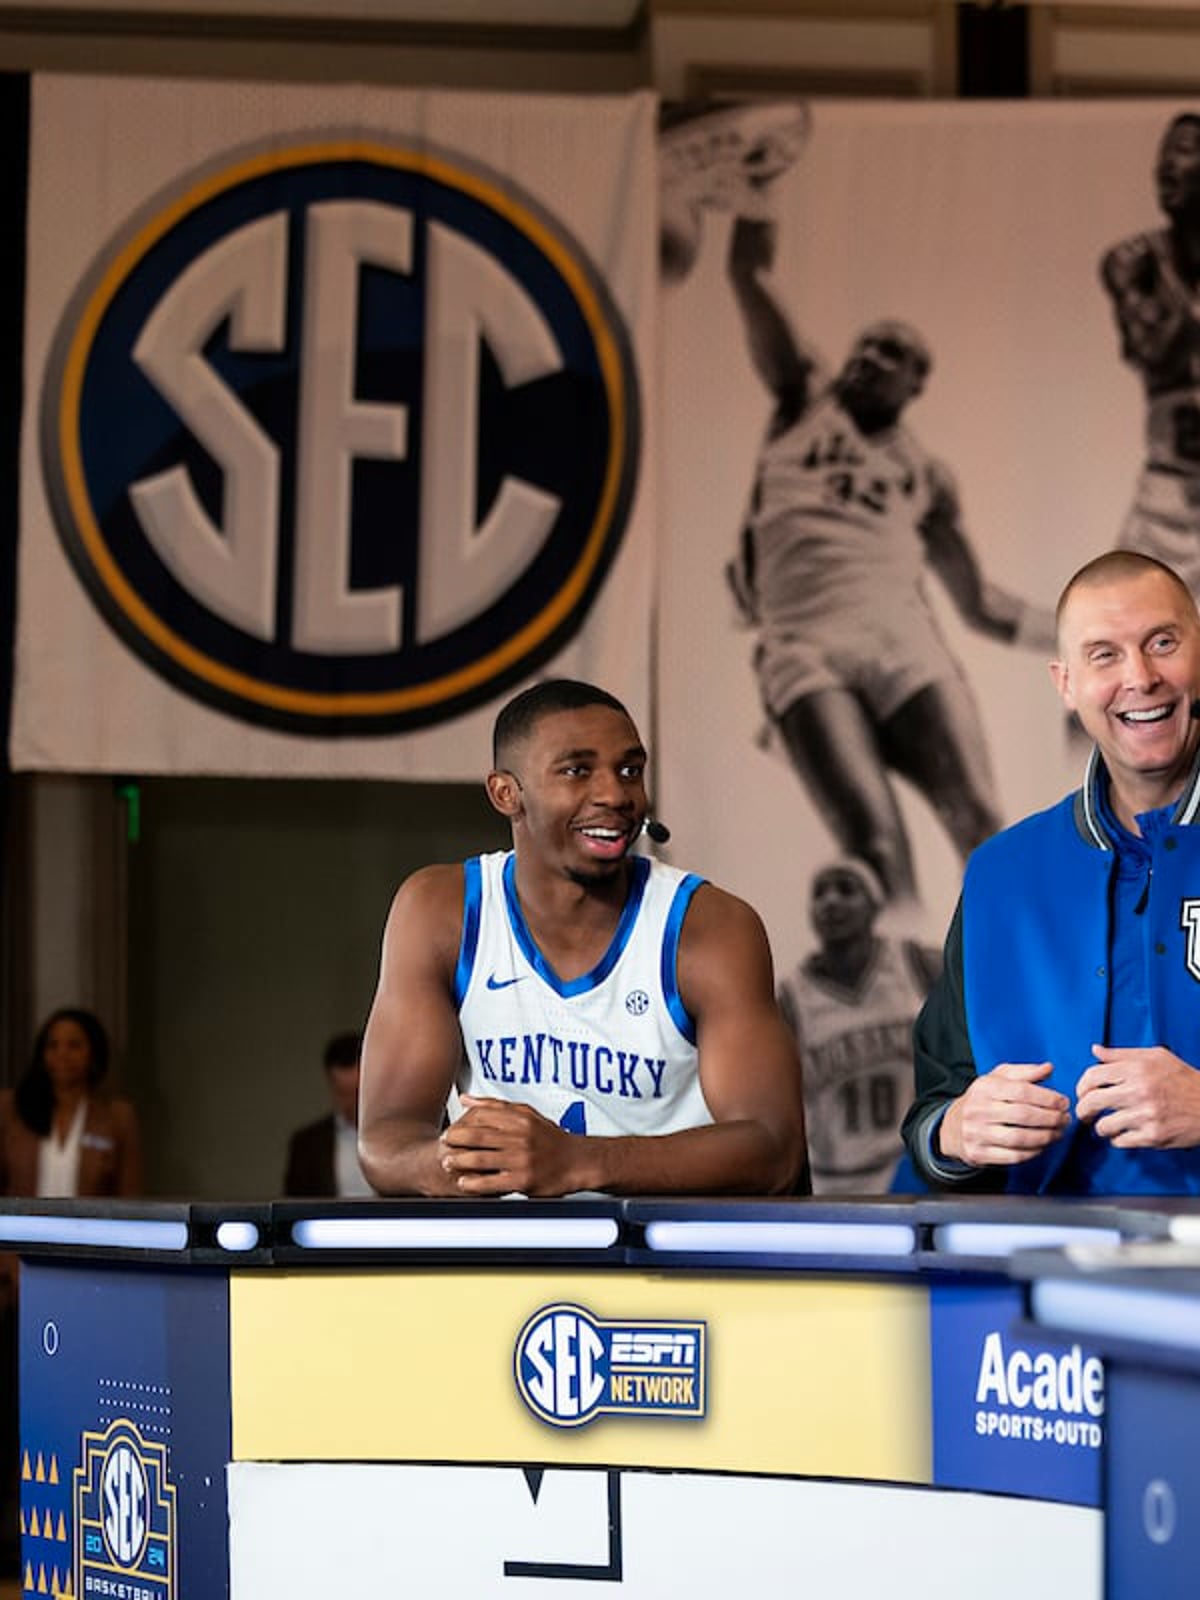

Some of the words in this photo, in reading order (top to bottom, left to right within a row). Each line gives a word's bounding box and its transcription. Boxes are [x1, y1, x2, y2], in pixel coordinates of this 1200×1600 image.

[129, 198, 564, 657] SEC
[476, 1033, 666, 1099] KENTUCKY
[840, 1075, 897, 1134] 10
[525, 1315, 605, 1416] SEC
[610, 1333, 696, 1364] ESPN
[975, 1332, 1105, 1417] Acade
[611, 1375, 695, 1404] NETWORK
[104, 1448, 145, 1561] SEC
[86, 1535, 101, 1552] 20
[148, 1548, 165, 1567] 24
